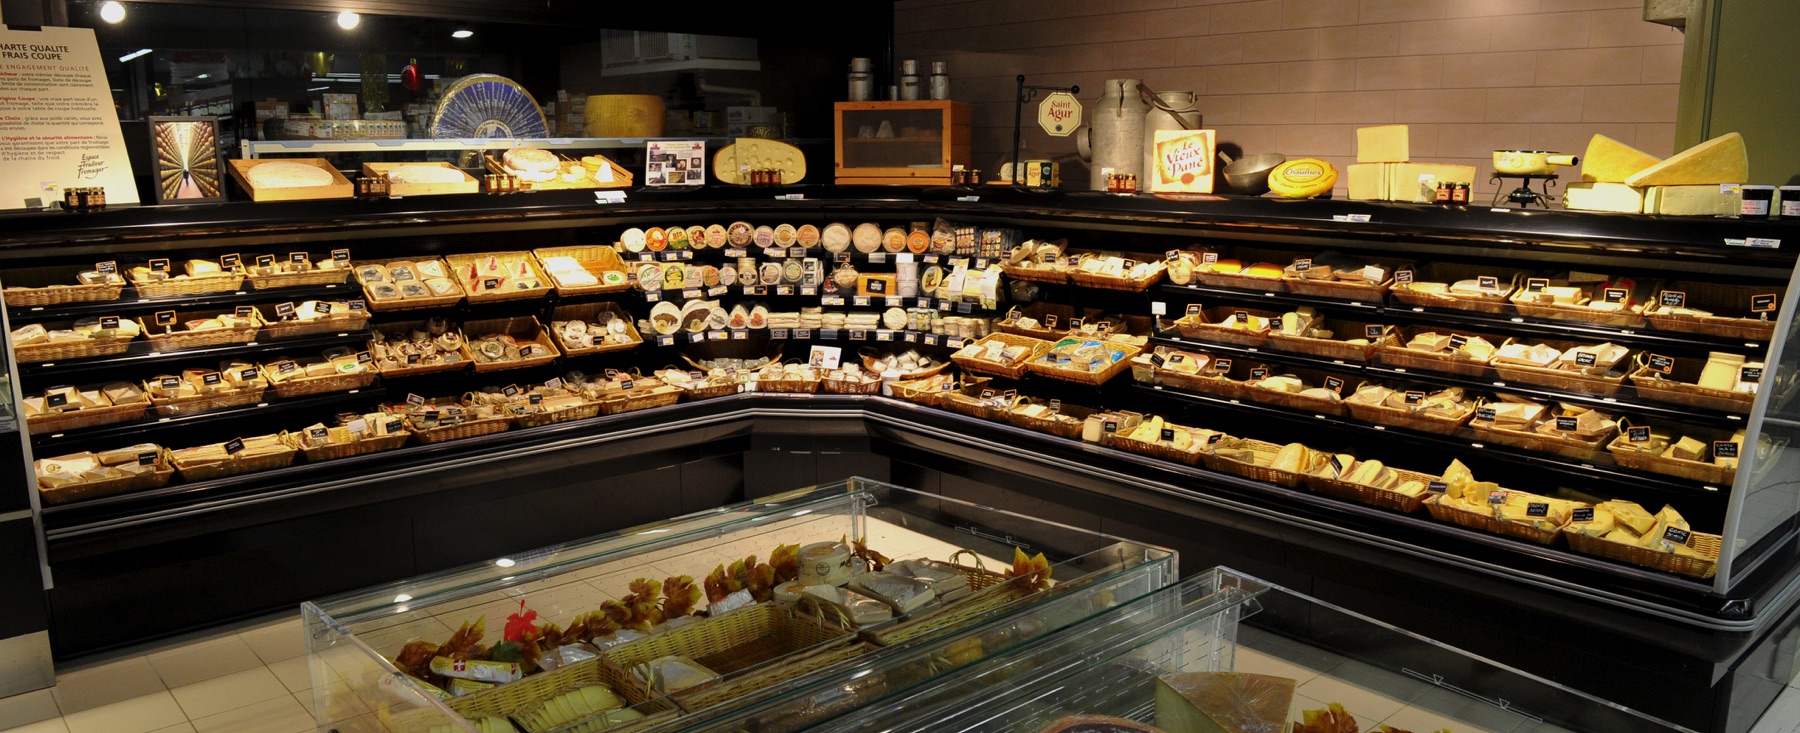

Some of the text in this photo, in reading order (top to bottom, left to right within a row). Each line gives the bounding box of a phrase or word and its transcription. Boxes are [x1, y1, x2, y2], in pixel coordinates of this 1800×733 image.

[30, 45, 69, 53] QUALITE
[31, 52, 62, 60] COUPE
[1051, 100, 1071, 109] Saint
[1048, 107, 1073, 122] Agur
[1183, 141, 1193, 151] Le
[1167, 148, 1201, 165] Vieux
[1284, 168, 1322, 177] Chaumes
